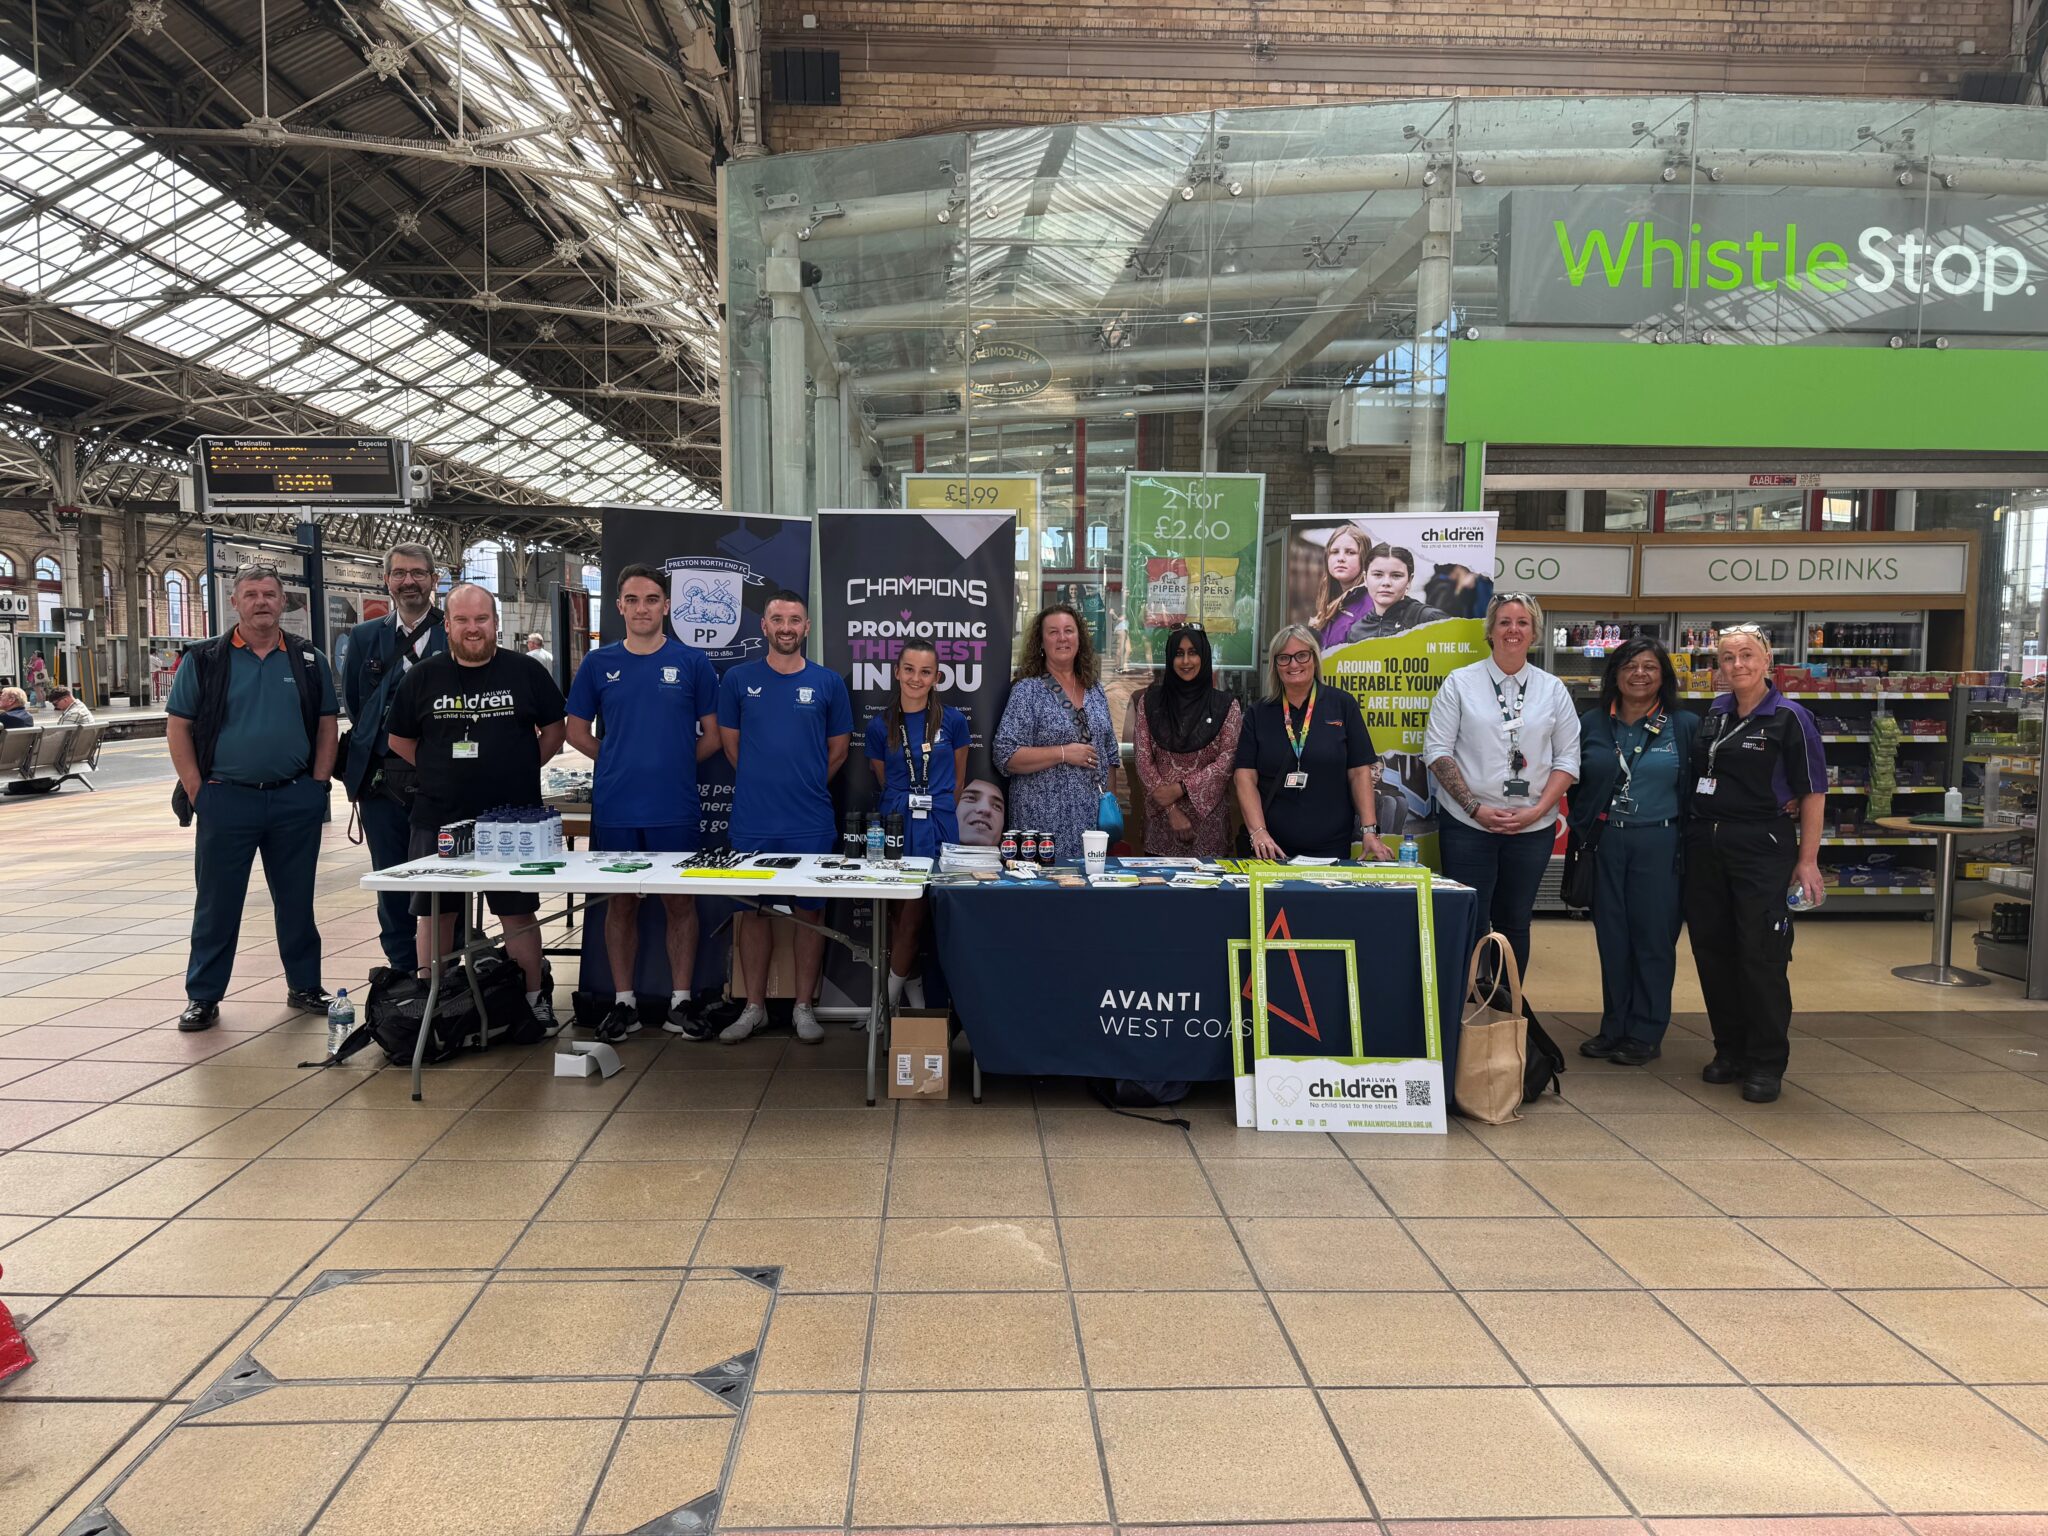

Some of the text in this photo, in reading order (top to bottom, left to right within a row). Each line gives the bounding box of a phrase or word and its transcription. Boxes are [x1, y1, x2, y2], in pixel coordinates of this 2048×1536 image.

[208, 440, 388, 448] Time Destination Expected
[1752, 475, 1780, 485] AABLE
[944, 484, 998, 504] £5.99
[1162, 481, 1224, 509] 2 for
[1154, 516, 1230, 540] £2.60
[1421, 528, 1484, 541] children
[216, 549, 226, 561] 4a
[236, 552, 250, 563] Train
[334, 566, 347, 577] Train
[348, 568, 372, 579] Information
[668, 560, 748, 574] PRESTON NORTH END FC
[1515, 557, 1560, 580] GO
[1708, 558, 1898, 582] COLD DRINKS
[846, 578, 988, 607] CHAMPIONS
[1152, 585, 1186, 593] PIPERS
[1193, 586, 1230, 595] PPERS
[694, 628, 718, 643] PP
[848, 620, 986, 638] PROMOTING
[848, 640, 987, 661] THE EST
[1426, 642, 1436, 653] IN
[1439, 642, 1456, 654] THE
[1336, 658, 1428, 675] AROUND 10,000
[852, 663, 982, 692] IN OU
[1324, 676, 1448, 692] ULNERABLE YOUN
[434, 694, 514, 710] children
[1368, 696, 1389, 710] ARE
[1392, 696, 1428, 710] FOUND
[1367, 712, 1430, 728] RAIL NET
[1402, 731, 1424, 744] EVE
[1088, 850, 1104, 858] child
[1100, 990, 1200, 1012] AVANTI
[1100, 1016, 1252, 1038] WEST COAS
[1308, 1078, 1398, 1098] children
[1362, 1102, 1372, 1110] the
[1347, 1120, 1432, 1128] WWW.RAILWAYCHILDREN.ORG.UK
